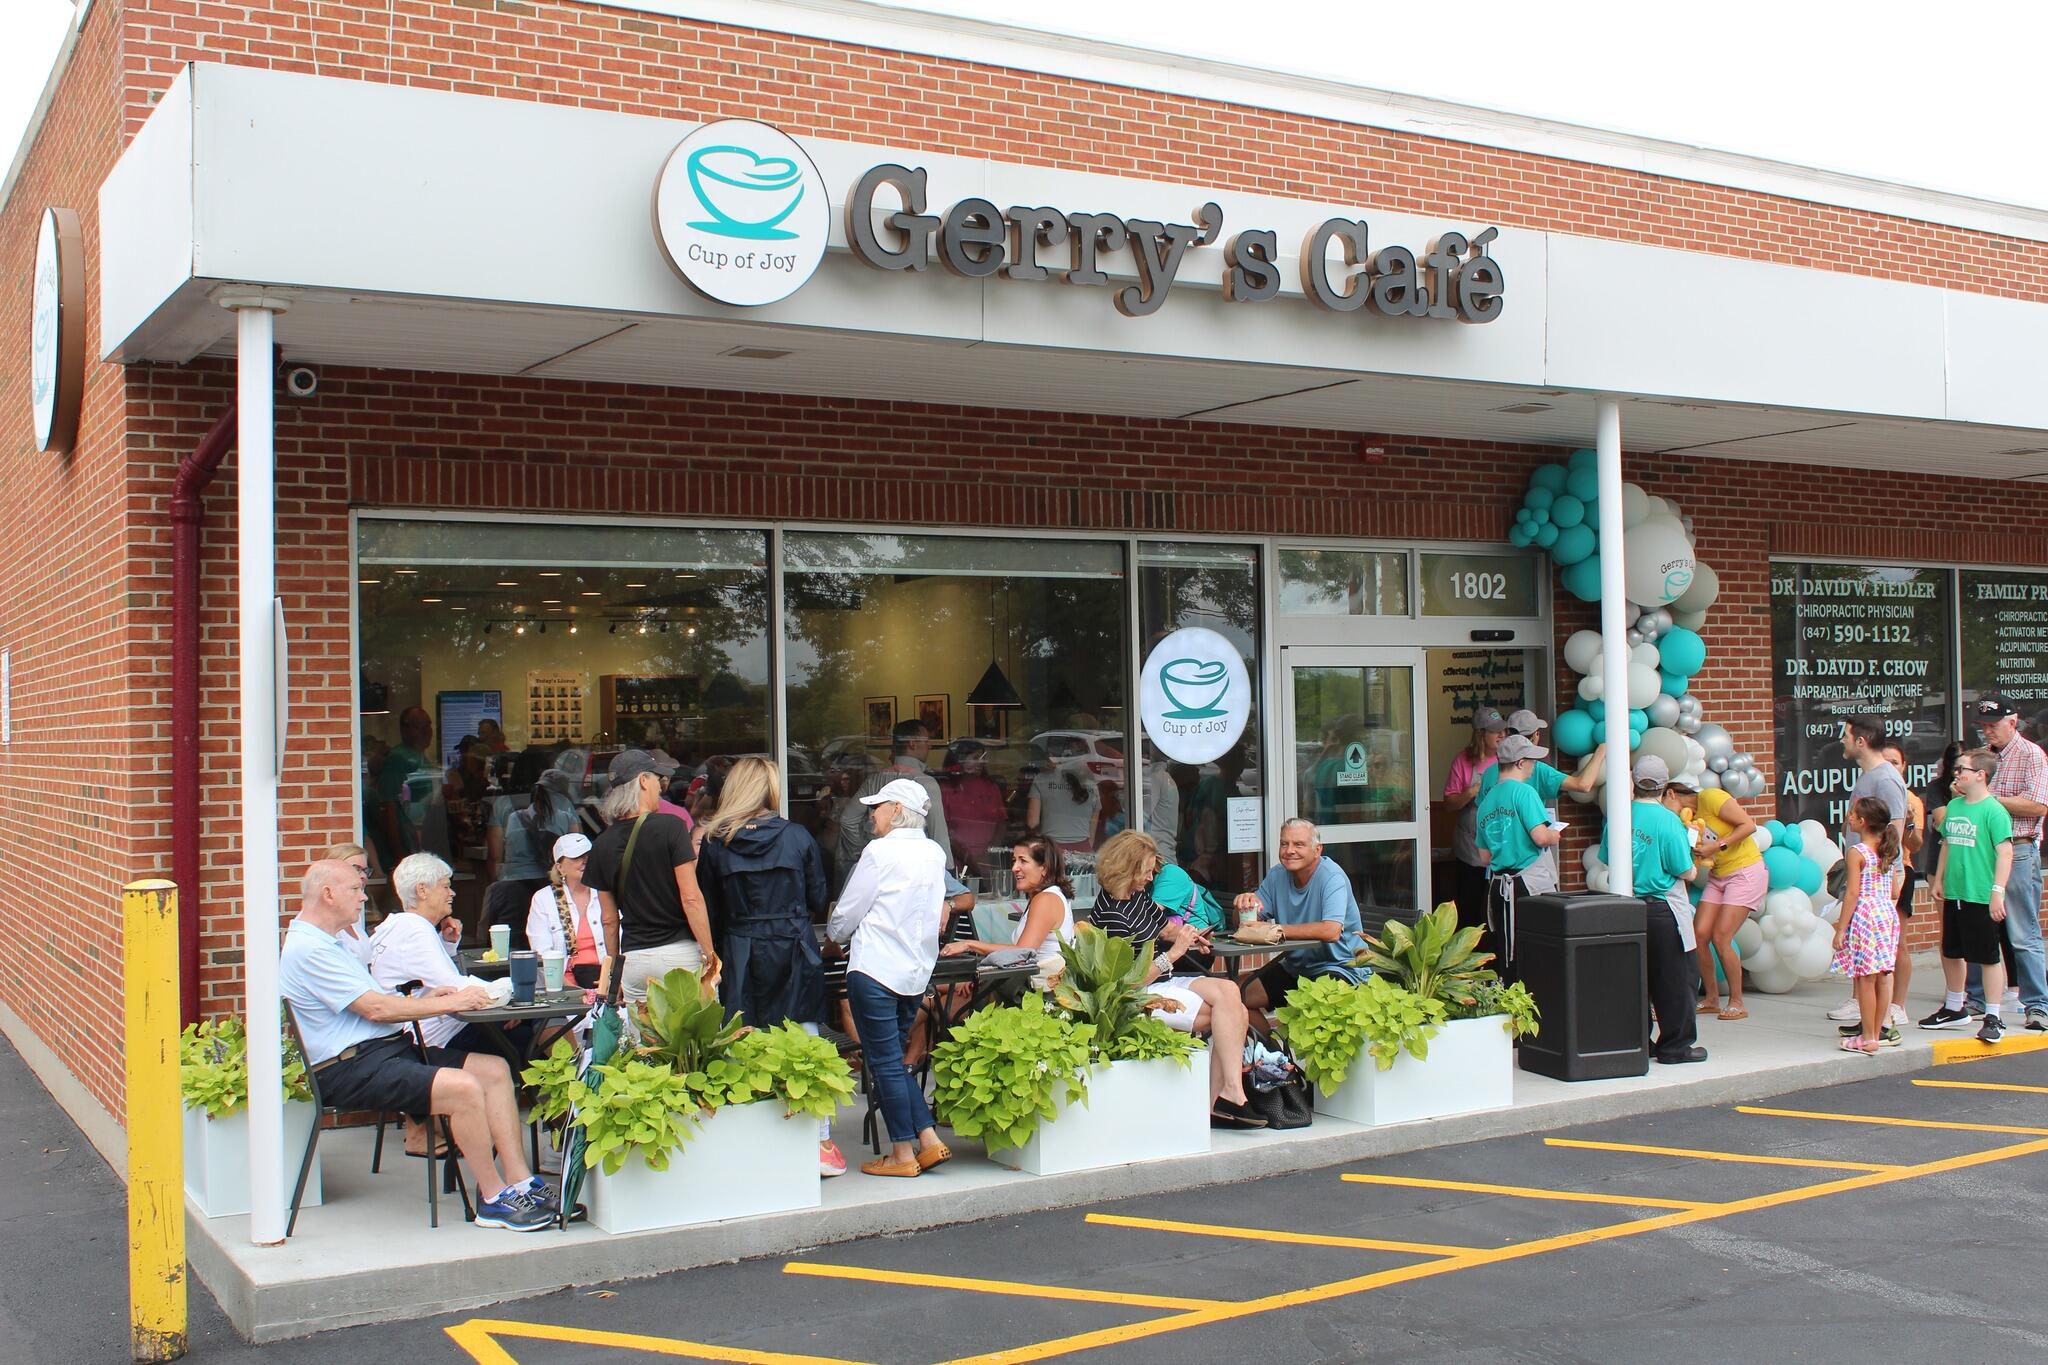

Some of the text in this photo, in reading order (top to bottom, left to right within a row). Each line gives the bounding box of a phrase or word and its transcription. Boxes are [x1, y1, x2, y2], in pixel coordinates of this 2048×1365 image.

[845, 163, 1504, 324] Gerry's Café
[688, 243, 797, 272] Cup of Joy
[1450, 572, 1506, 600] 1802
[1771, 578, 1936, 599] DR. DAVID W. FIEDLER
[1976, 584, 2029, 600] FAMILY
[1796, 604, 1914, 619] CHIROPRACTIC PHYSICIAN
[1998, 611, 2048, 622] CHIROPRACTIC
[1802, 625, 1911, 643] (847) 590-1132
[1998, 627, 2036, 638] ACTIVATOR
[1785, 658, 1929, 677] DR. DAVID F. CHOW
[1999, 657, 2036, 669] NUTRITION
[1793, 685, 1849, 699] NAPRAPATH
[1855, 684, 1923, 699] ACUPUNCTURE
[1831, 703, 1892, 715] Board Certified
[1162, 720, 1228, 736] Cup of Joy
[1805, 723, 1834, 738] (847)
[1782, 763, 1938, 796] ACUPUURE
